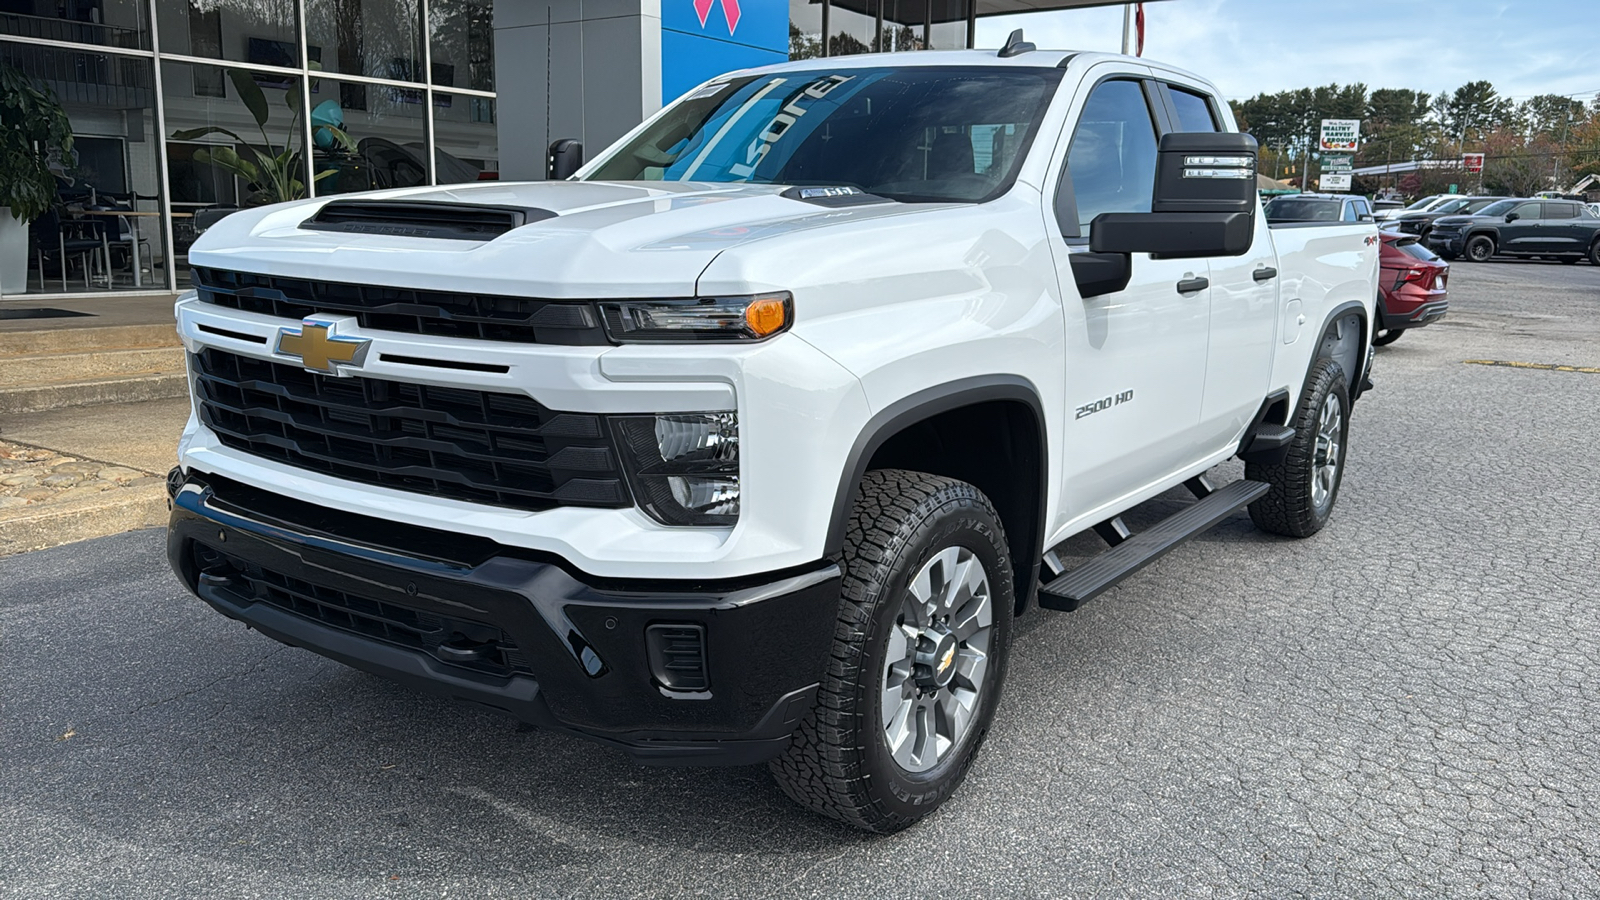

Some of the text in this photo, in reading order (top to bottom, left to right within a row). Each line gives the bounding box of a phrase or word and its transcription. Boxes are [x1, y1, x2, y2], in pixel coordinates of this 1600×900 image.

[343, 224, 436, 236] CHEVROLET
[1075, 389, 1134, 420] 2500 HD
[905, 517, 1006, 588] GOODYEAR
[889, 727, 987, 806] WRANGLER
